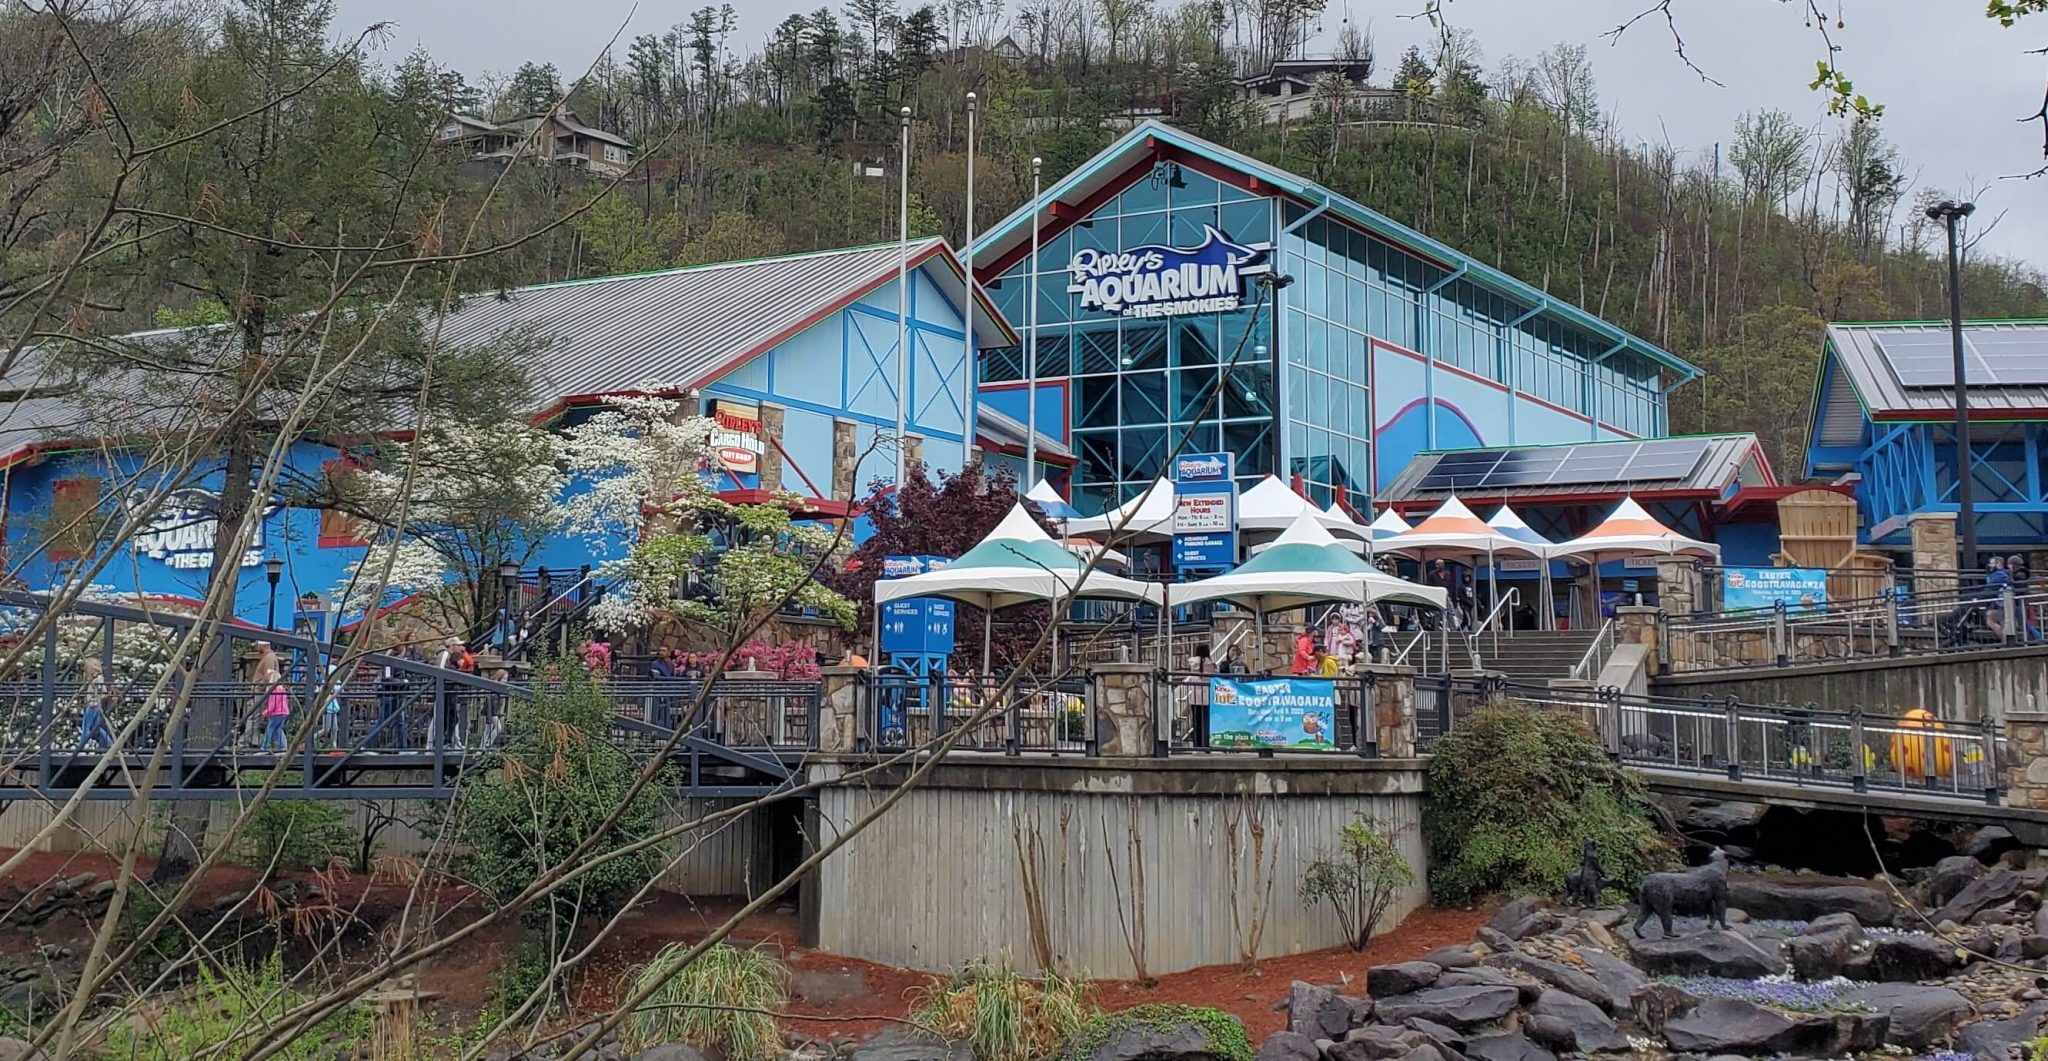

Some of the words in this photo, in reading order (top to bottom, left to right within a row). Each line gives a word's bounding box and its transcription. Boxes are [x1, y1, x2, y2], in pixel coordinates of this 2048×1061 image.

[1072, 249, 1164, 282] Ripley's
[1080, 262, 1238, 312] AQUARIUM
[1133, 302, 1164, 318] THE
[1163, 296, 1238, 316] SMOKIES
[715, 409, 763, 434] RIPLEY'S
[710, 430, 741, 448] CARGO
[741, 432, 765, 455] HOLD
[1181, 466, 1220, 478] AQUARIUM
[1190, 506, 1211, 514] HOURS
[174, 553, 199, 569] THE
[886, 566, 919, 575] AQUARIUM
[1759, 571, 1791, 579] EASTER
[1255, 682, 1291, 695] EASTER
